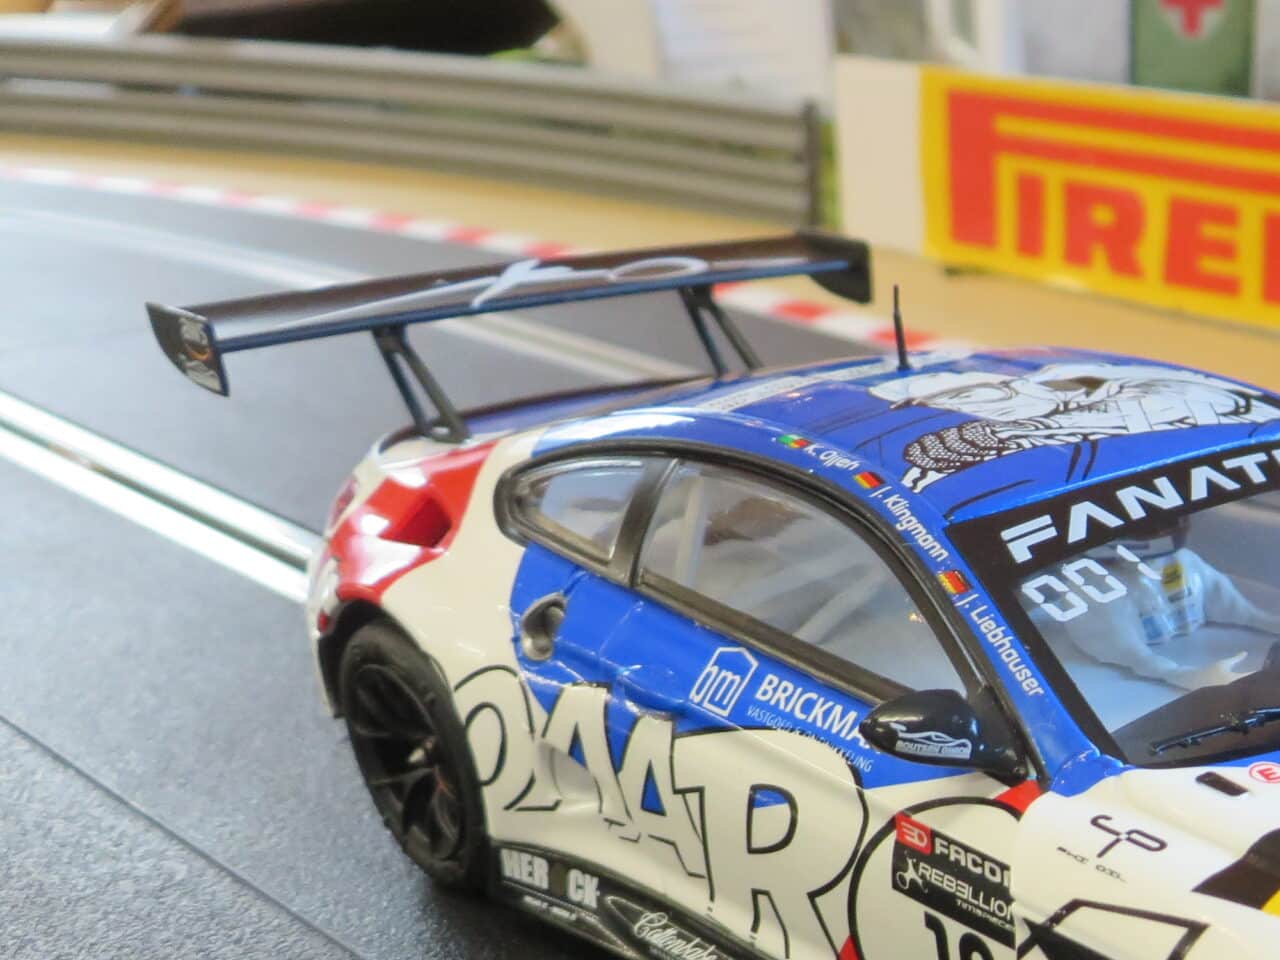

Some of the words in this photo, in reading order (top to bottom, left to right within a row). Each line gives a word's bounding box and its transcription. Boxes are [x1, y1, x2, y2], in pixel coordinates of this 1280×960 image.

[883, 494, 949, 563] Klingmann
[971, 605, 1044, 698] Liebhauser
[755, 673, 876, 752] BRICKMA
